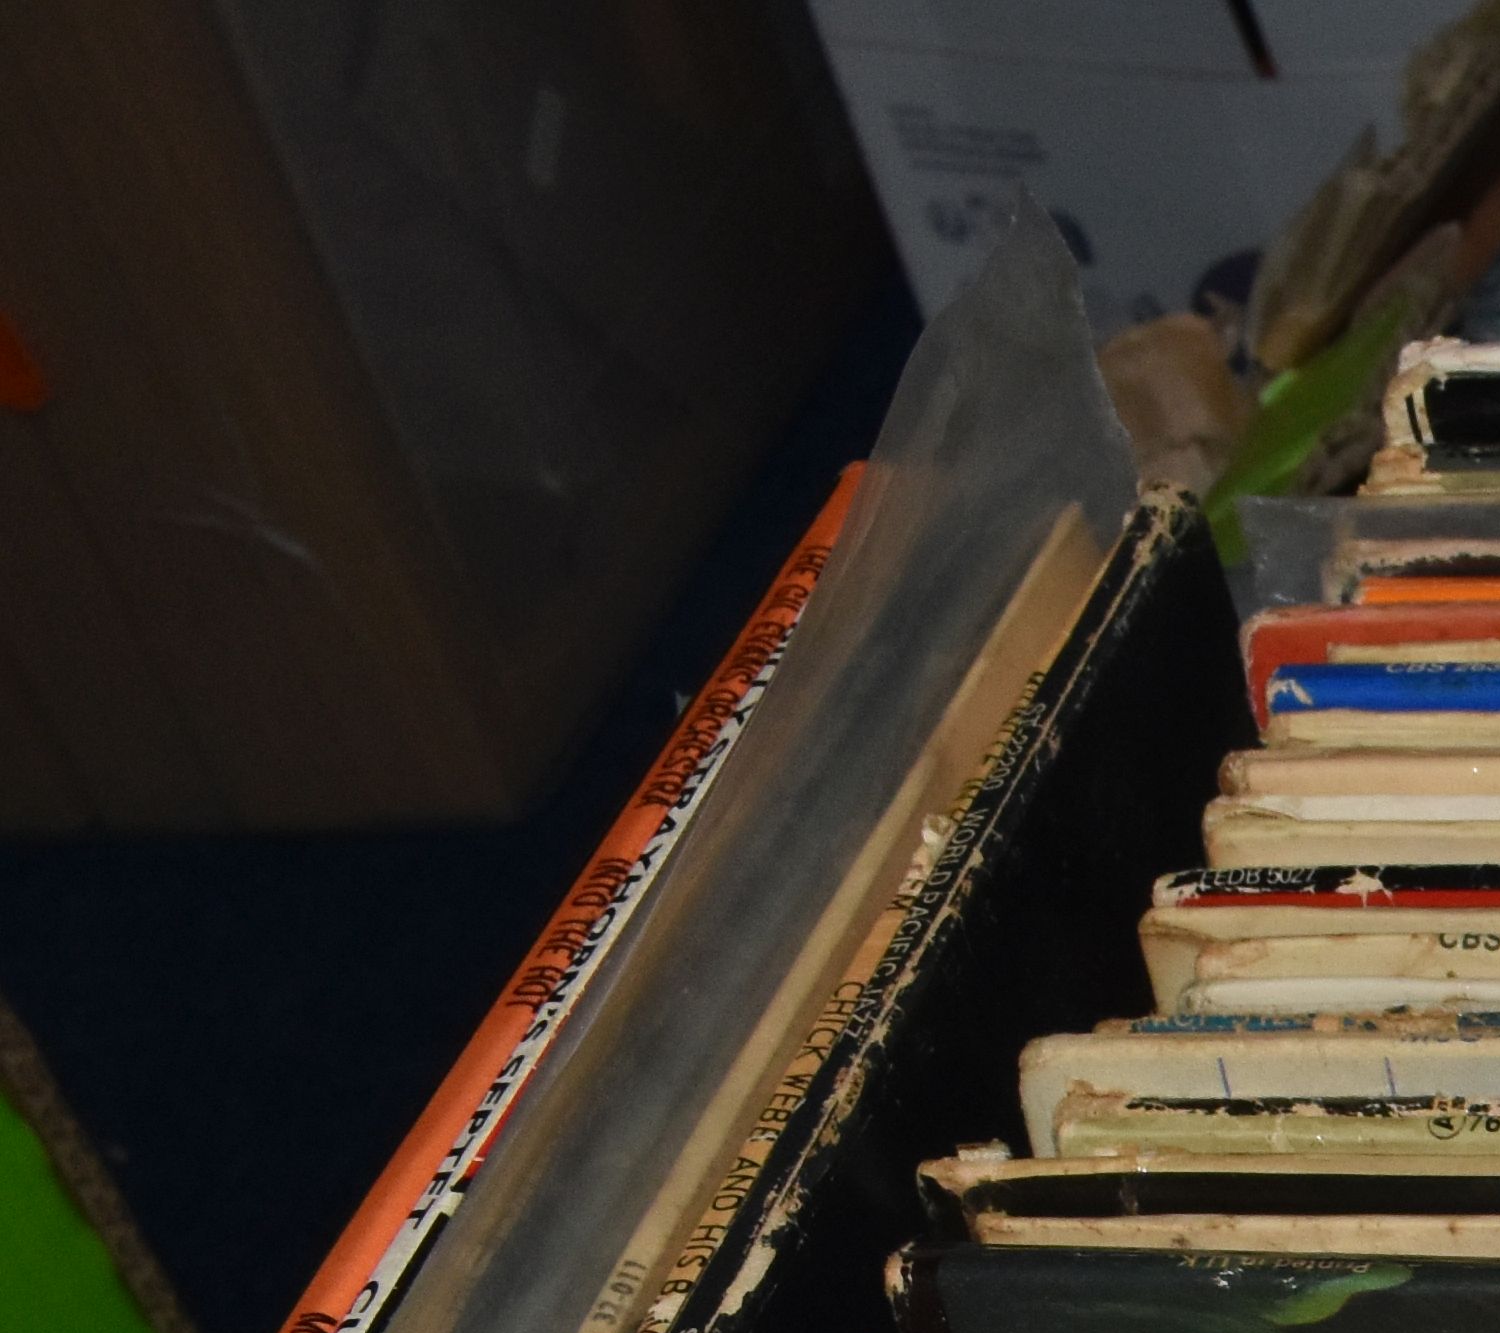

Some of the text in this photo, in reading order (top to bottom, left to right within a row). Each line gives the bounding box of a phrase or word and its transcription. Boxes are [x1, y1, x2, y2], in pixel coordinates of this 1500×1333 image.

[684, 980, 863, 1272] CHICK AND HIS
